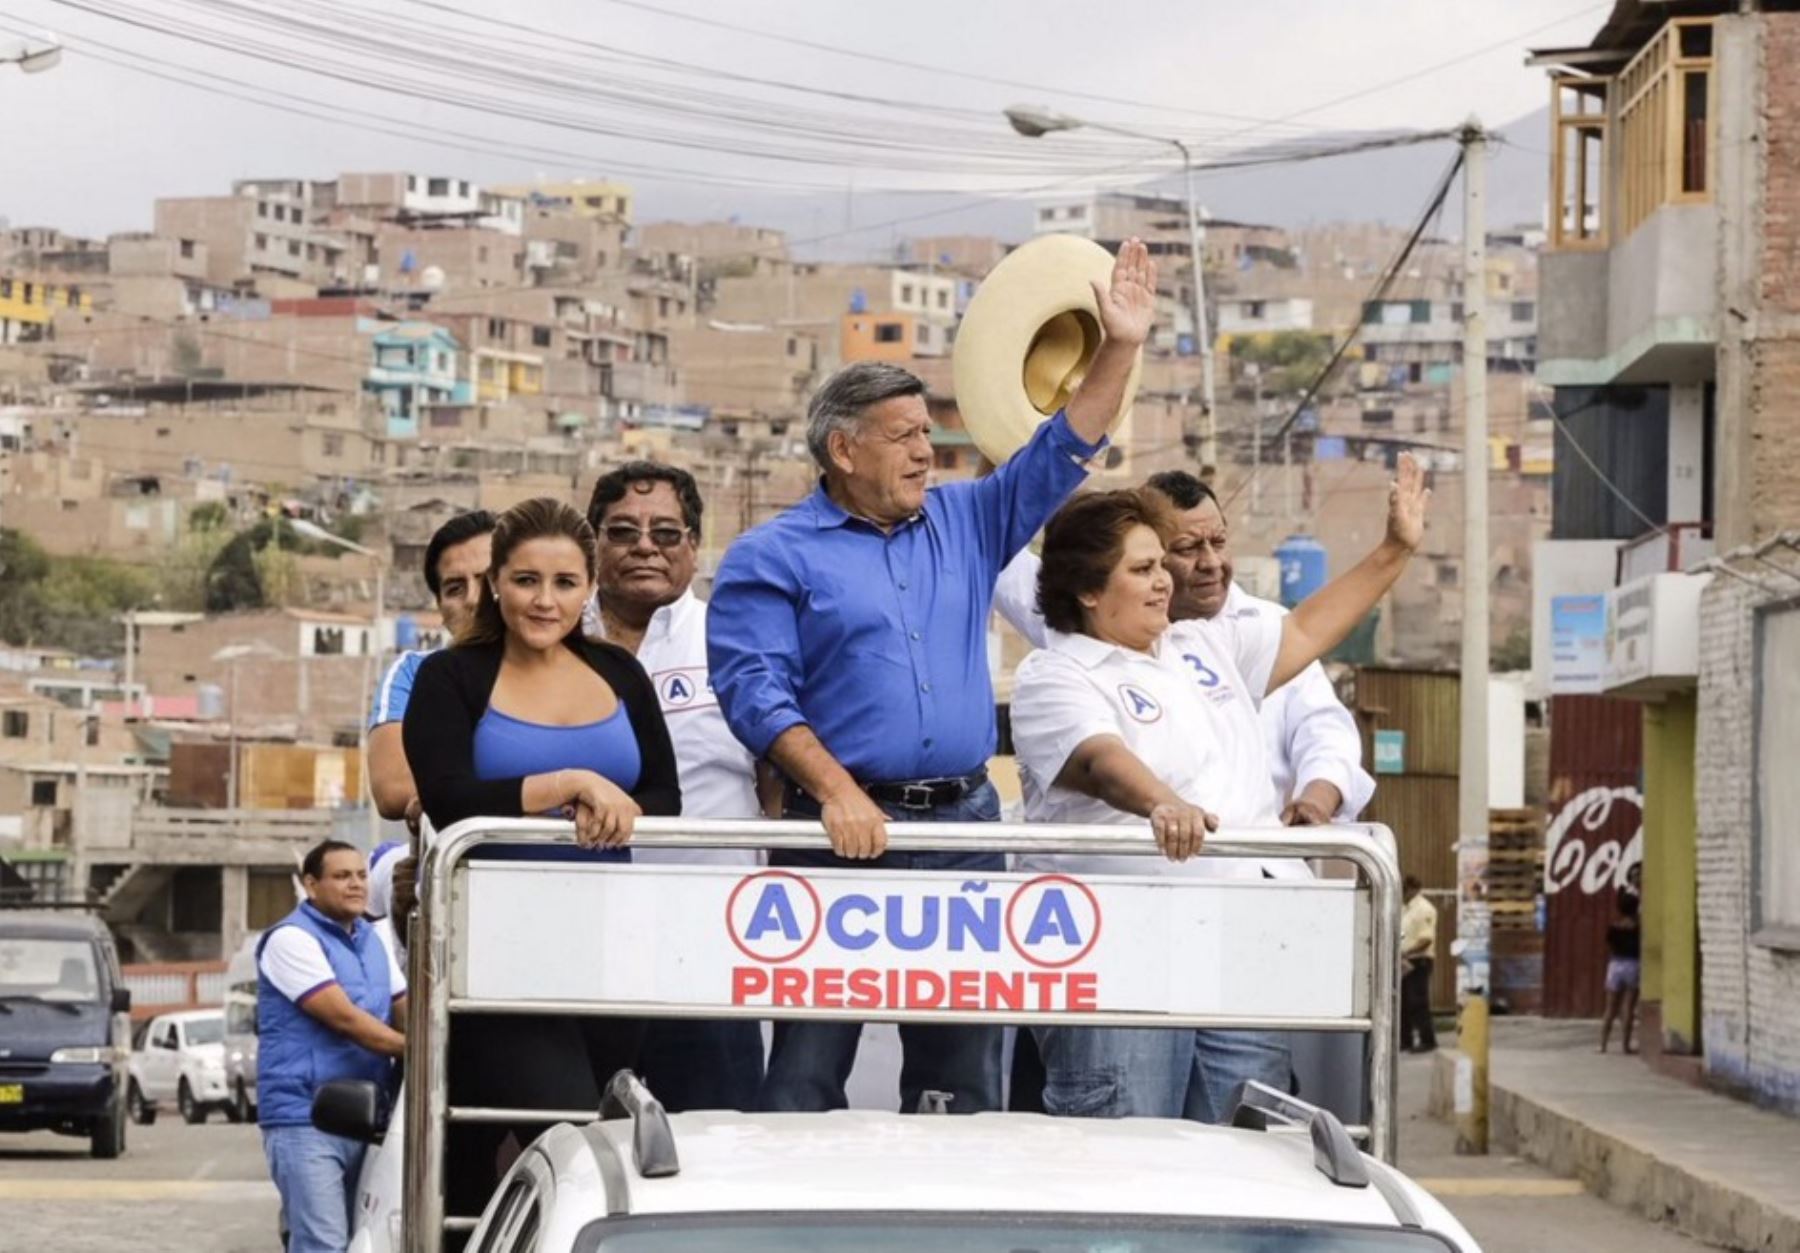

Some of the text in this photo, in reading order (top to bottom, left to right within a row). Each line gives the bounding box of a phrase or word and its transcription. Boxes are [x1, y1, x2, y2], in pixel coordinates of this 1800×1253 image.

[1182, 654, 1219, 687] 3
[669, 678, 689, 699] A
[1127, 689, 1156, 714] A
[744, 881, 1082, 952] ACUÑA
[732, 967, 1097, 1012] PRESIDENTE
